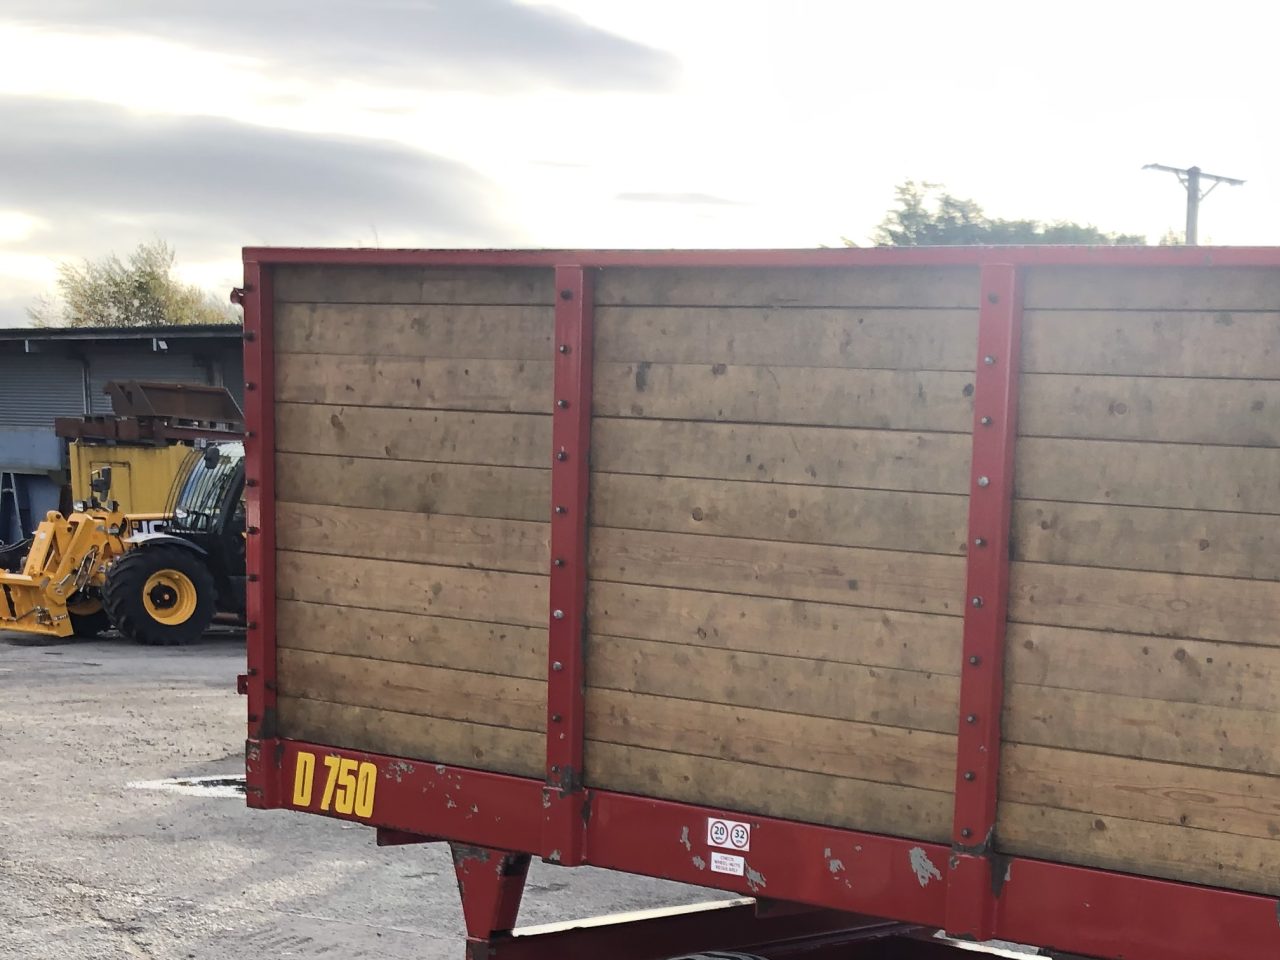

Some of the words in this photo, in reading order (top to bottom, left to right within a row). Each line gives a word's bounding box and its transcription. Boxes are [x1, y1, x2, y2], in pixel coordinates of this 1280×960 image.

[131, 519, 171, 537] JC
[293, 751, 315, 806] D
[320, 755, 377, 818] 750
[714, 826, 725, 835] 20
[735, 829, 745, 839] 32
